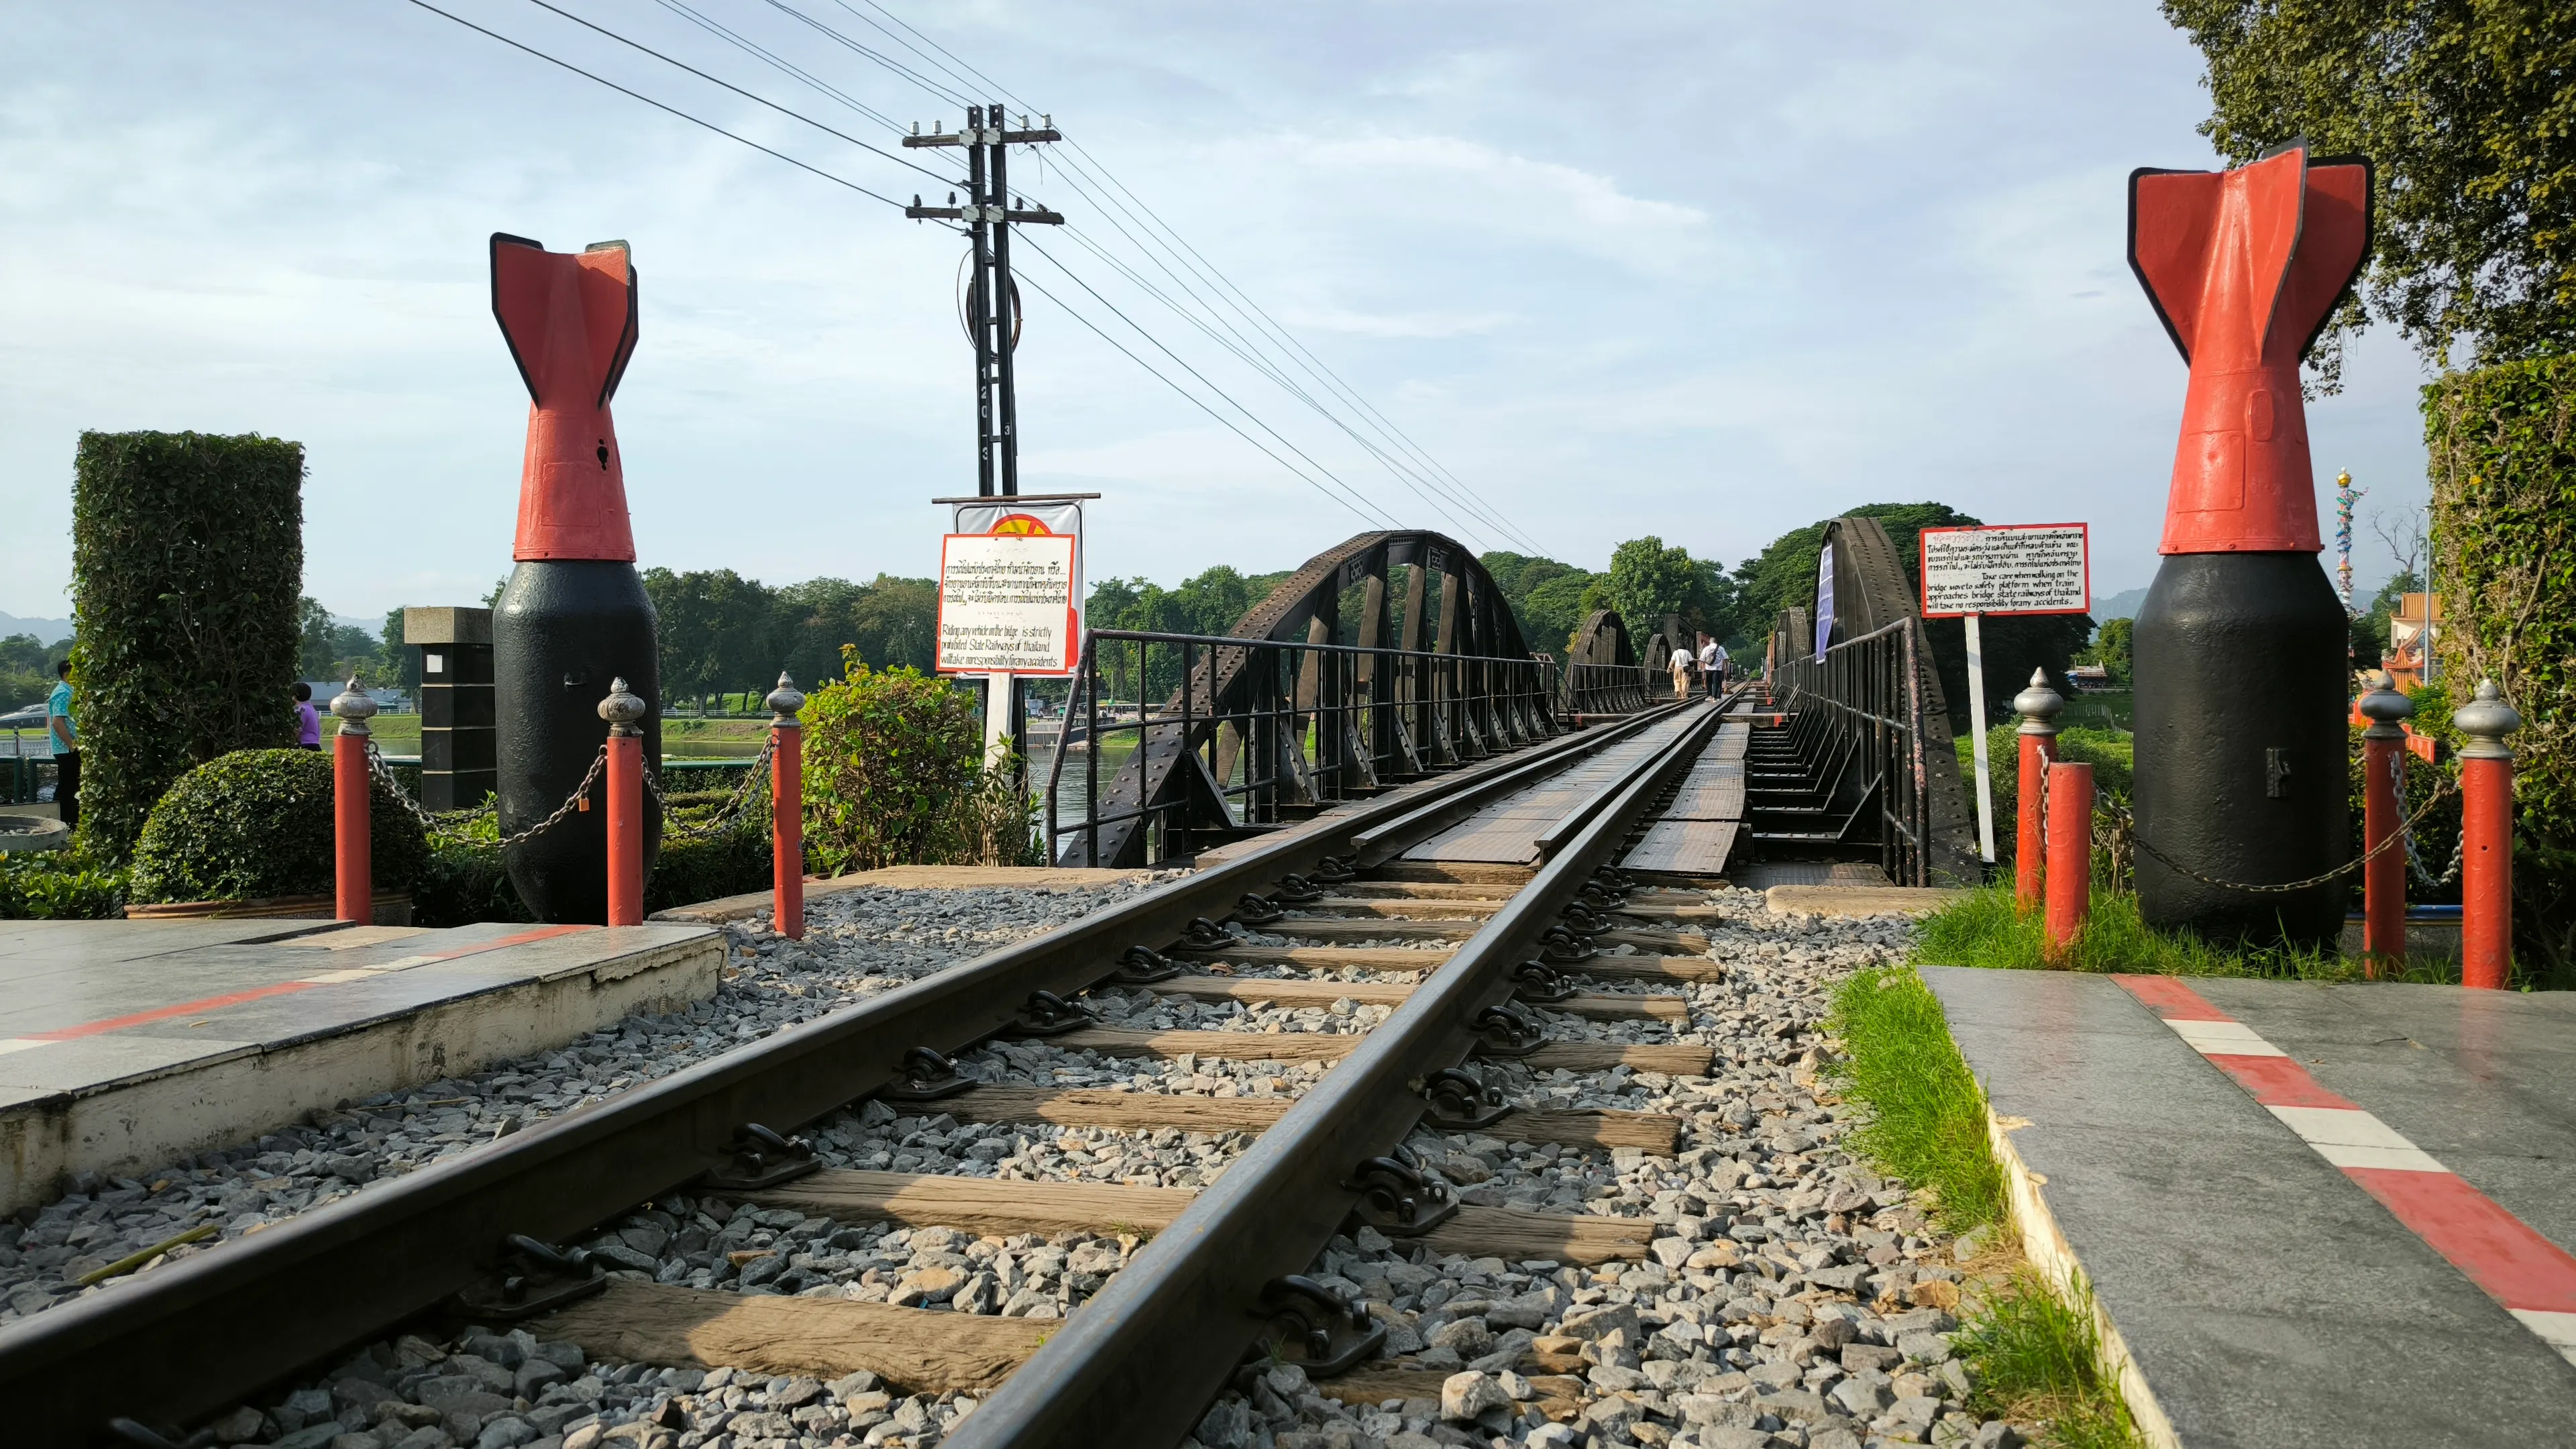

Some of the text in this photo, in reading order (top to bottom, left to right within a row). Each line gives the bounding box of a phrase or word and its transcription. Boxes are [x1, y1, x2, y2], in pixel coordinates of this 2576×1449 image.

[1927, 583, 1947, 594] bridge
[1974, 580, 1995, 590] safety
[2033, 580, 2051, 588] when
[2056, 578, 2074, 587] train
[1927, 591, 1968, 602] approaches
[1972, 590, 1994, 601] bridge
[1029, 626, 1052, 640] strictly
